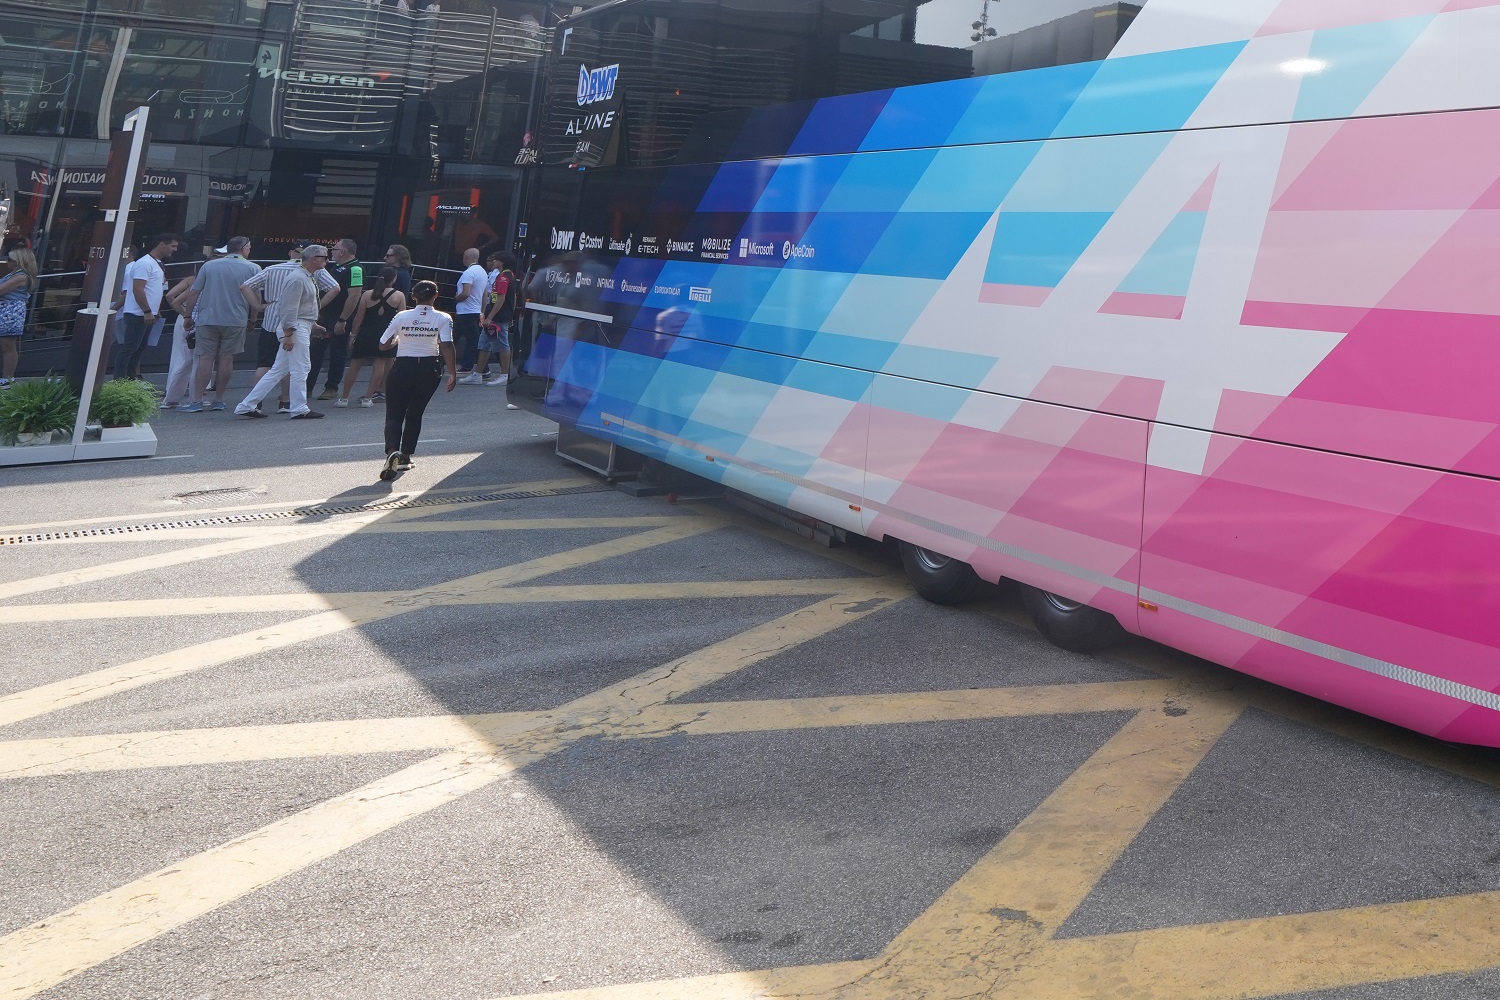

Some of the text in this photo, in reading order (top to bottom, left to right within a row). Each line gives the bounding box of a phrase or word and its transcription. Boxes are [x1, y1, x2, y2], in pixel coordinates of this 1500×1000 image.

[257, 67, 375, 88] McLaren
[586, 63, 620, 105] BWT
[556, 230, 575, 250] BWT
[585, 235, 604, 249] Castrol
[638, 241, 694, 254] E-TECH BINANCE
[748, 242, 815, 258] Microsoft ApeCoin
[688, 286, 712, 302] PIRELLI
